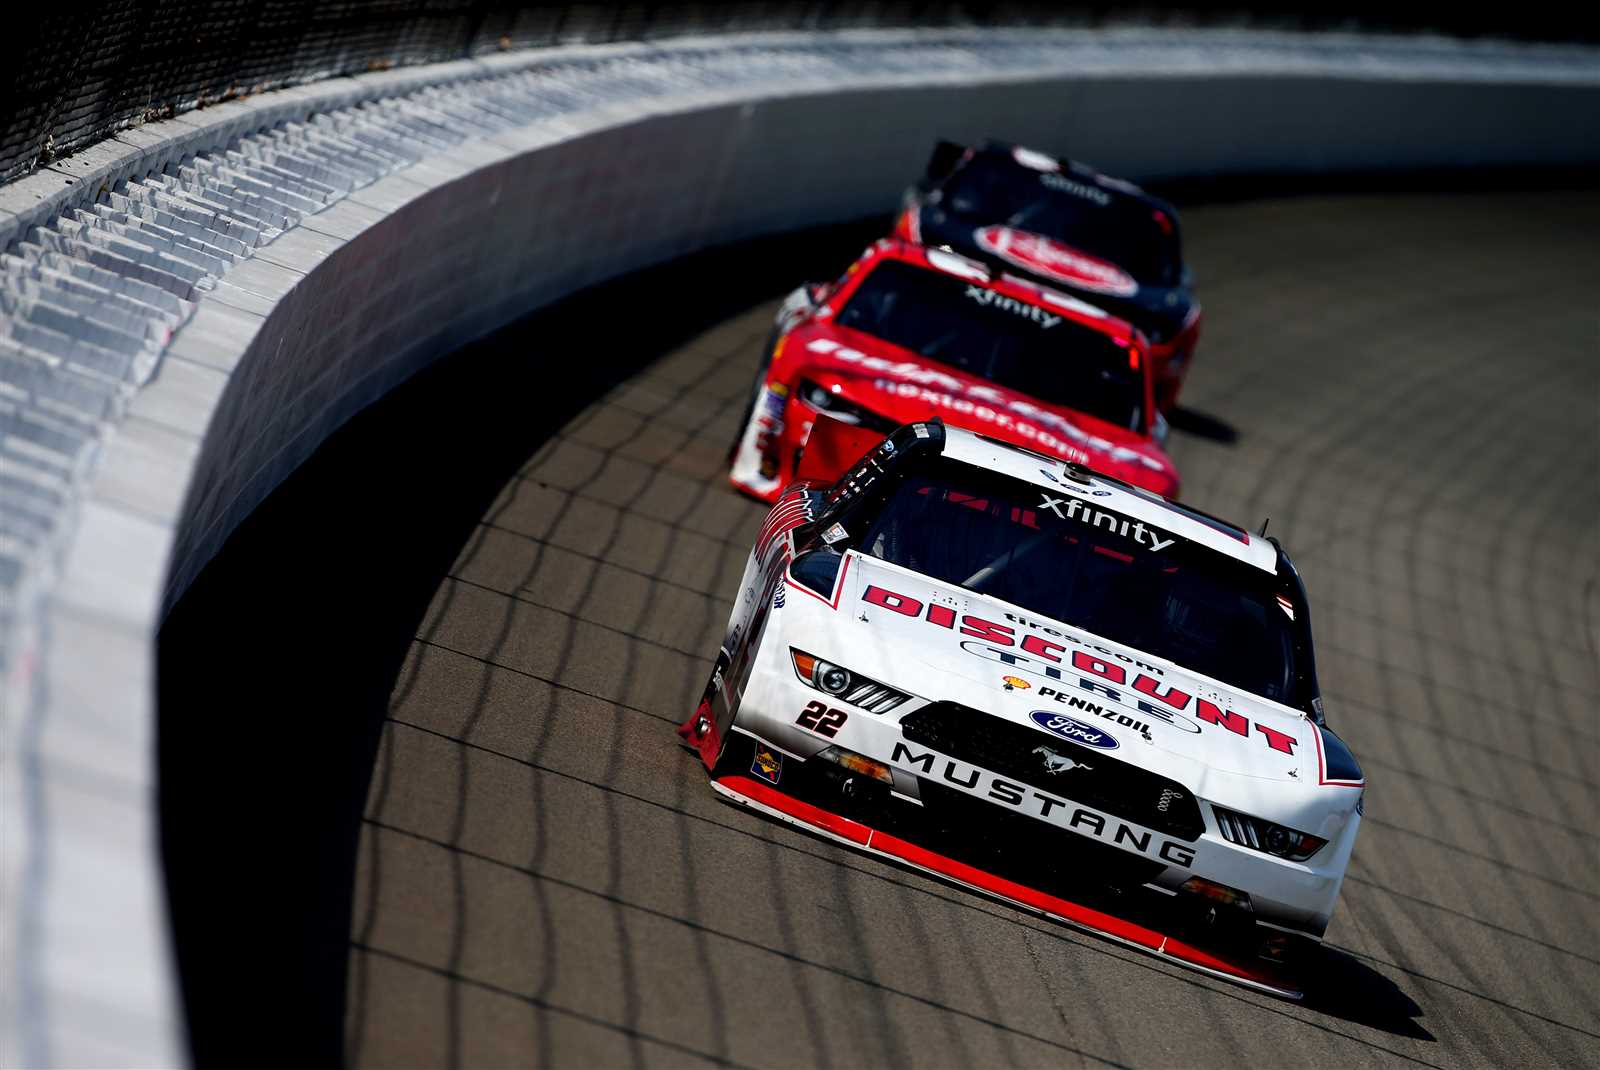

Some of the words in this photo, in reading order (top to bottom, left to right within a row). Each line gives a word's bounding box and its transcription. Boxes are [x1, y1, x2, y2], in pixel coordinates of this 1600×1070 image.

[964, 285, 1063, 330] xfinity
[1037, 493, 1175, 551] xfinity
[861, 584, 1299, 756] DISCOUNT
[1004, 613, 1164, 676] tires.com
[987, 648, 1176, 724] TIRE
[1038, 686, 1152, 734] PENNZOIL
[795, 700, 848, 738] 22
[1046, 715, 1103, 744] Ford
[890, 742, 1196, 868] MUSTANG
